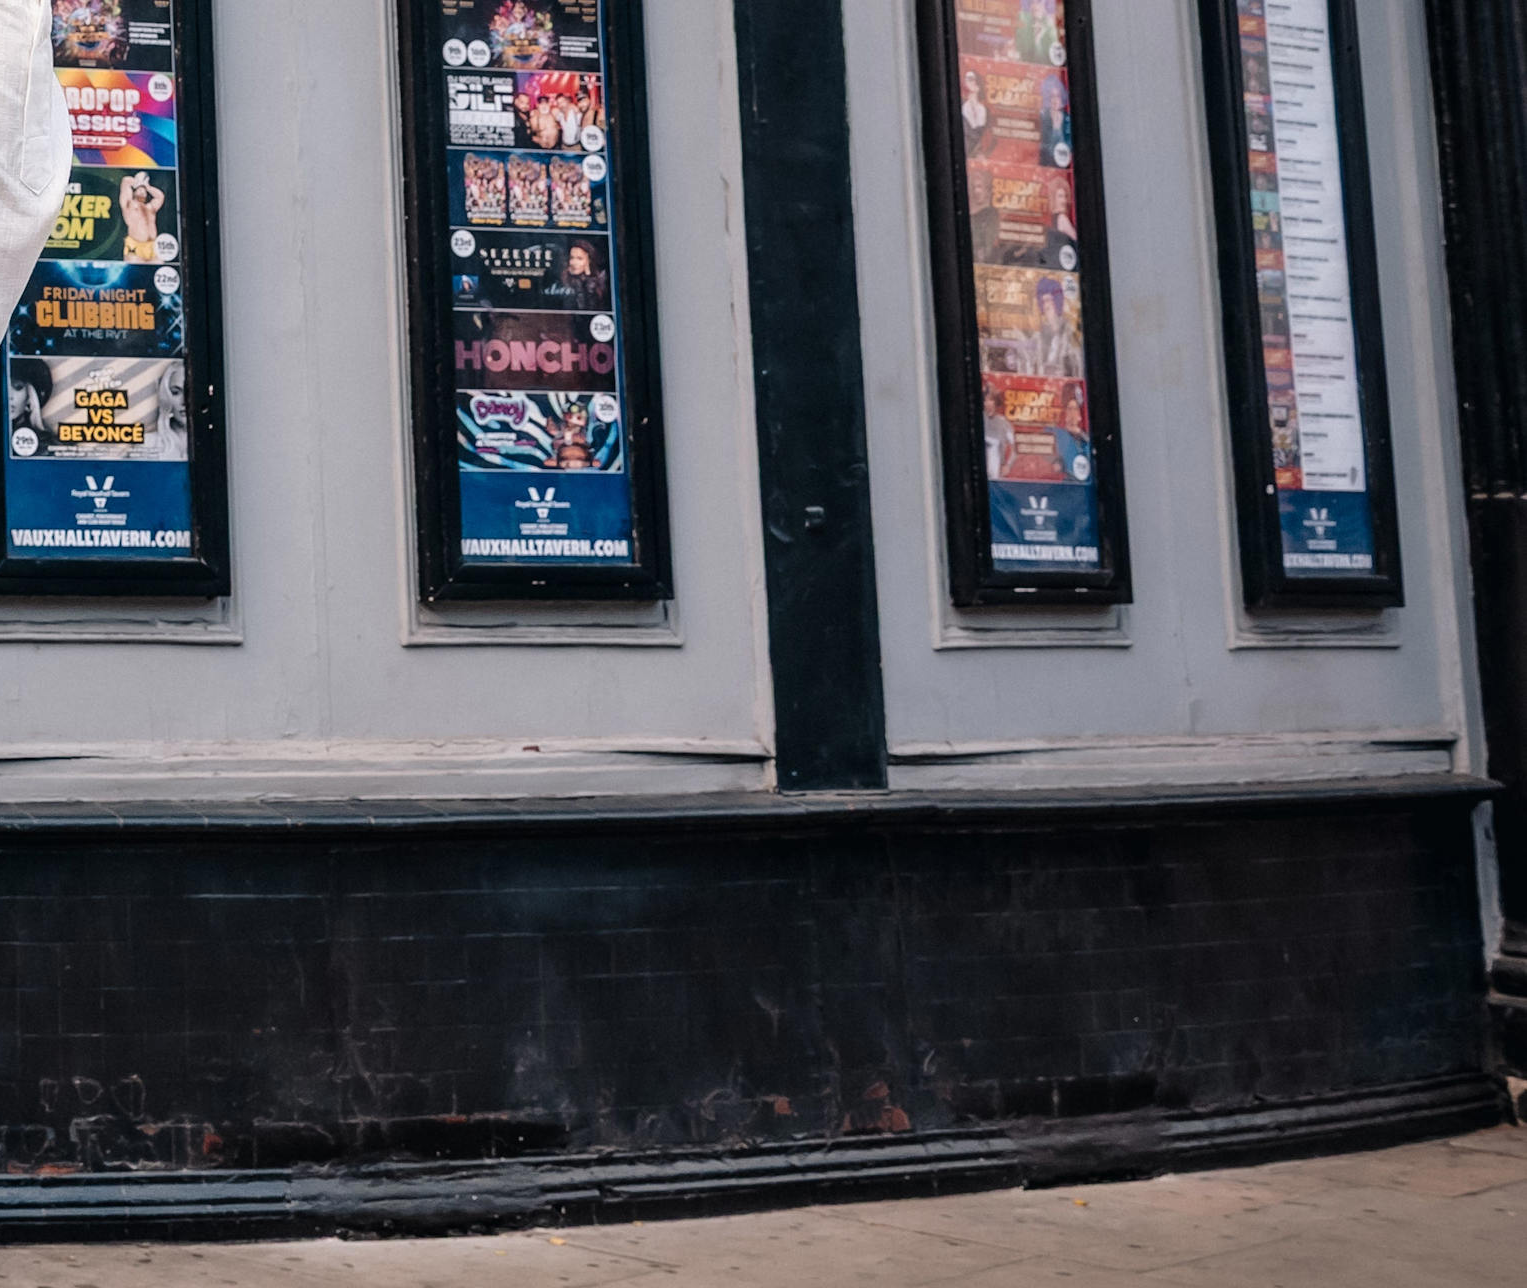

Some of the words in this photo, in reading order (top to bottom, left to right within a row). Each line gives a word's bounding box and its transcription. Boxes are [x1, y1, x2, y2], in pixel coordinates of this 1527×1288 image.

[156, 274, 178, 284] 22nd
[43, 286, 96, 302] FRIDAY
[98, 288, 147, 303] NIGHT
[35, 300, 156, 330] CLUBBING
[63, 328, 80, 338] AT
[82, 329, 104, 339] THE
[105, 329, 129, 340] RVT
[454, 339, 614, 374] HONCHO
[75, 391, 127, 408] GAGA
[89, 409, 113, 424] VS
[59, 423, 144, 442] BEYONCÉ
[11, 529, 191, 548] VAUXHALLTAVERN.COM
[461, 538, 628, 557] VAUXHALLTAVERN.COM
